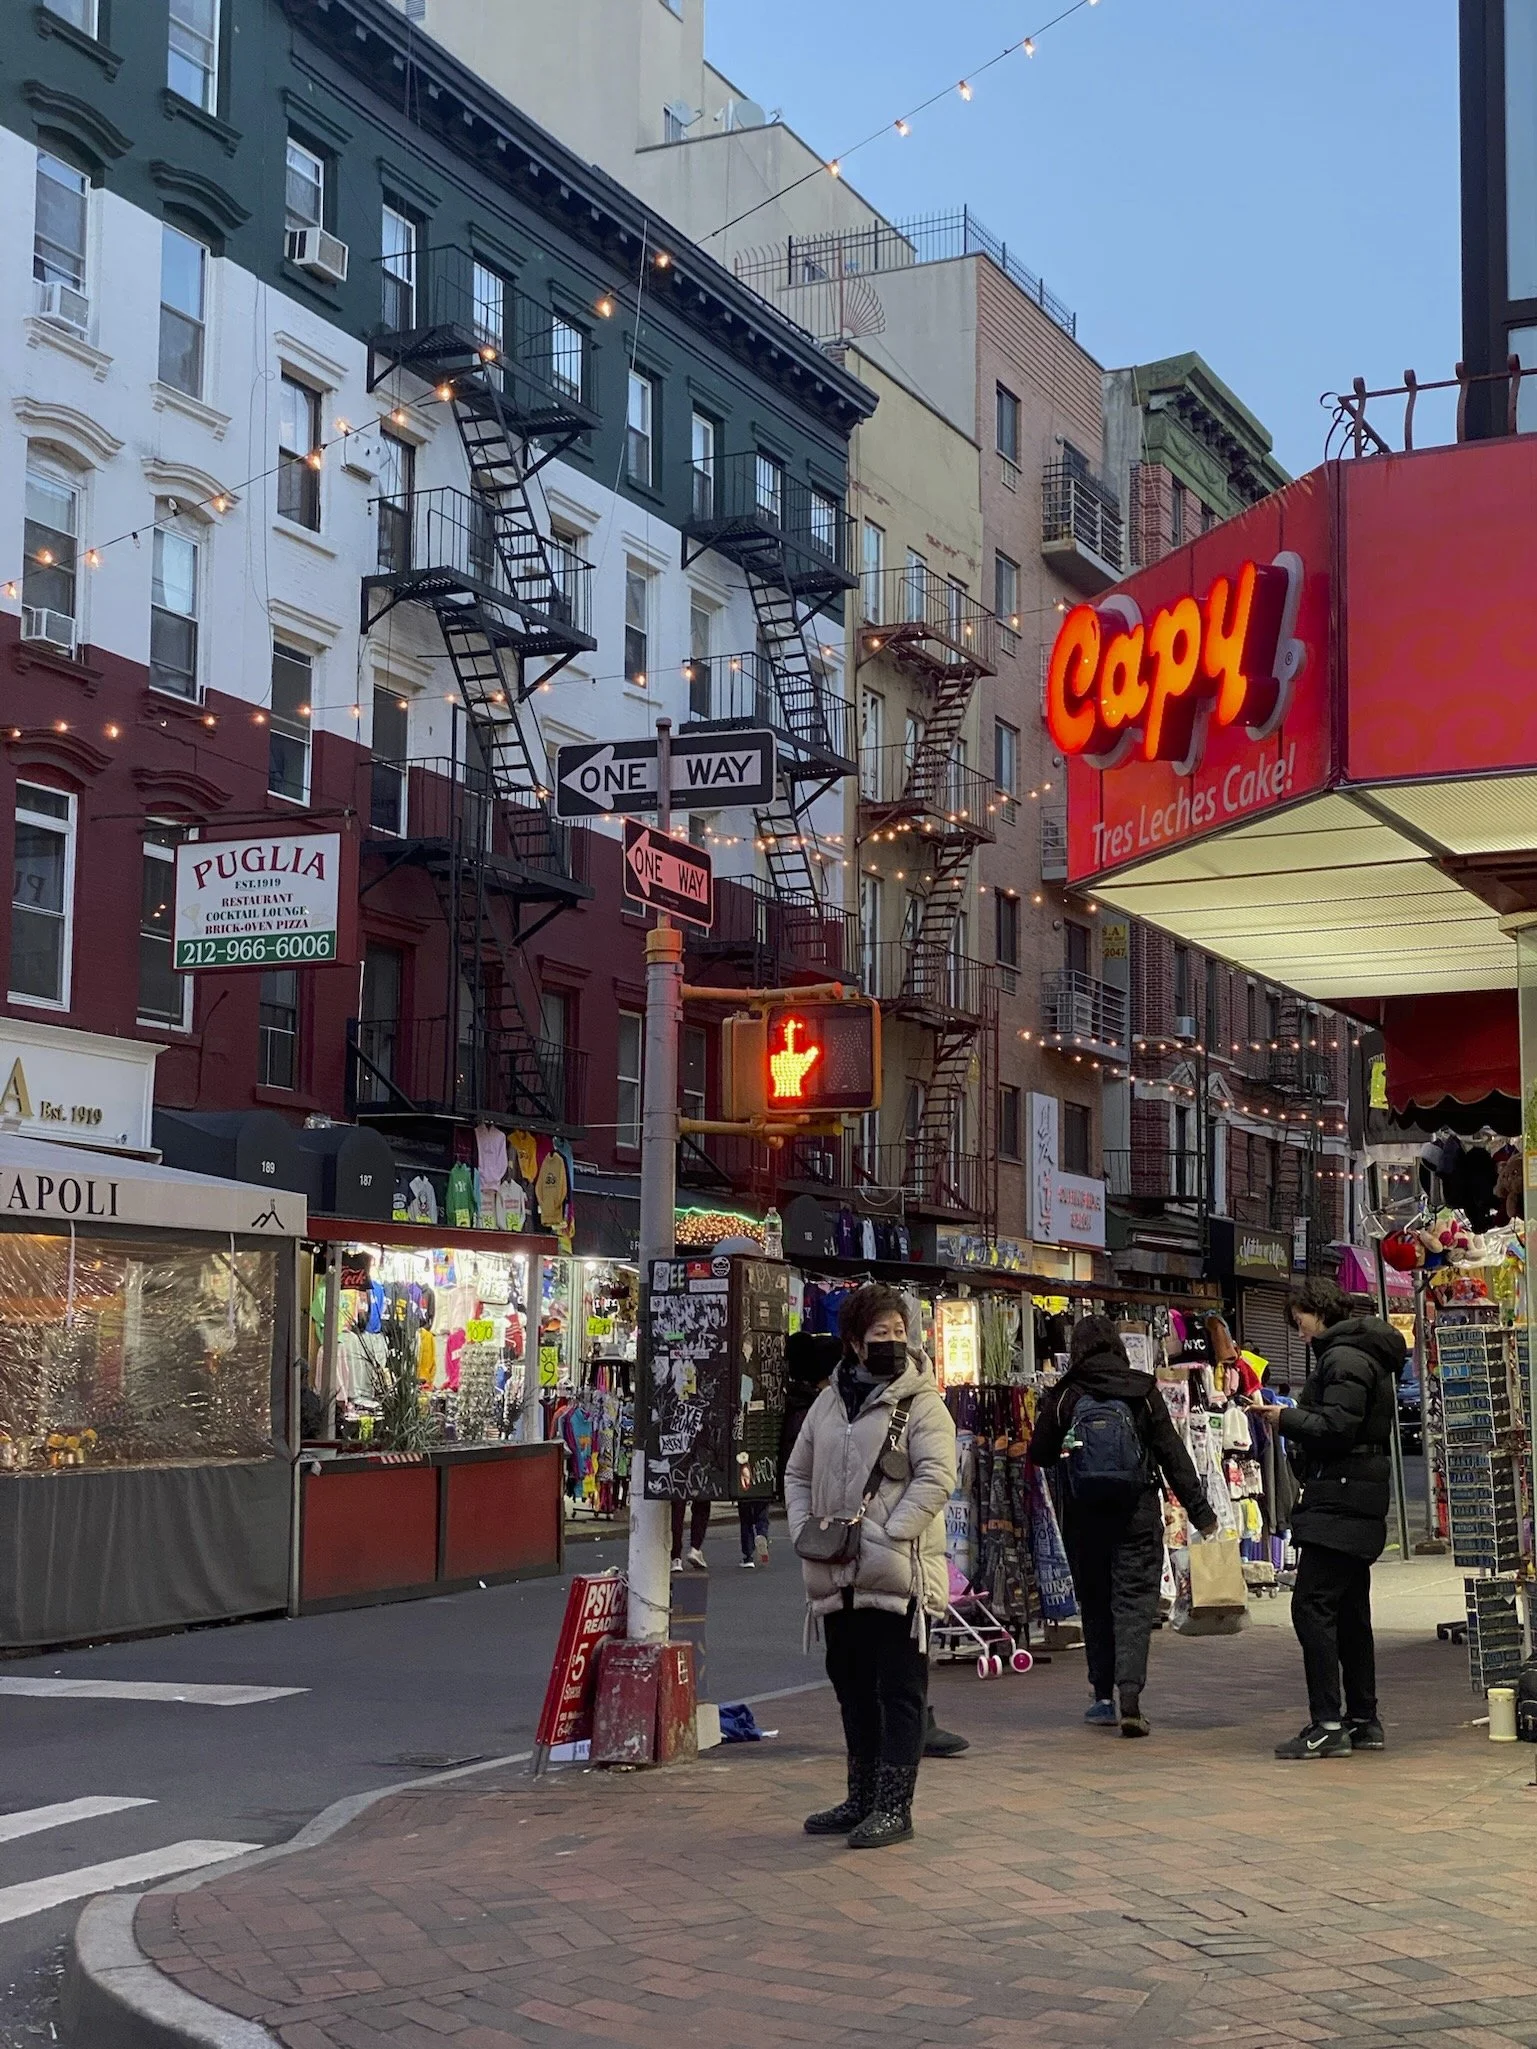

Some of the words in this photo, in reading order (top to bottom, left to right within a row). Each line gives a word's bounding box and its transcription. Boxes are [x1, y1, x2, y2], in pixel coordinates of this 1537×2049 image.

[1048, 561, 1254, 761] Capy
[580, 762, 647, 793] ONE
[686, 755, 753, 786] WAY
[1093, 820, 1132, 864] Tres
[1139, 786, 1217, 847] Leches
[1223, 742, 1296, 810] Cake!
[192, 845, 326, 890] PUGLIA
[634, 846, 663, 883] ONE
[678, 863, 704, 898] WAY
[206, 909, 259, 922] COCKTAIL
[262, 905, 308, 917] LOUNGE
[222, 893, 294, 907] RESTAURANT
[205, 922, 273, 935] BRICK-OVEN
[276, 919, 309, 930] PIZZA
[182, 934, 330, 964] 212-966-6006
[41, 1101, 66, 1122] Est.
[71, 1105, 103, 1126] 1919
[261, 1161, 275, 1174] 189
[359, 1174, 372, 1187] 187
[0, 1172, 119, 1217] APOLI
[1184, 1339, 1206, 1350] NYC
